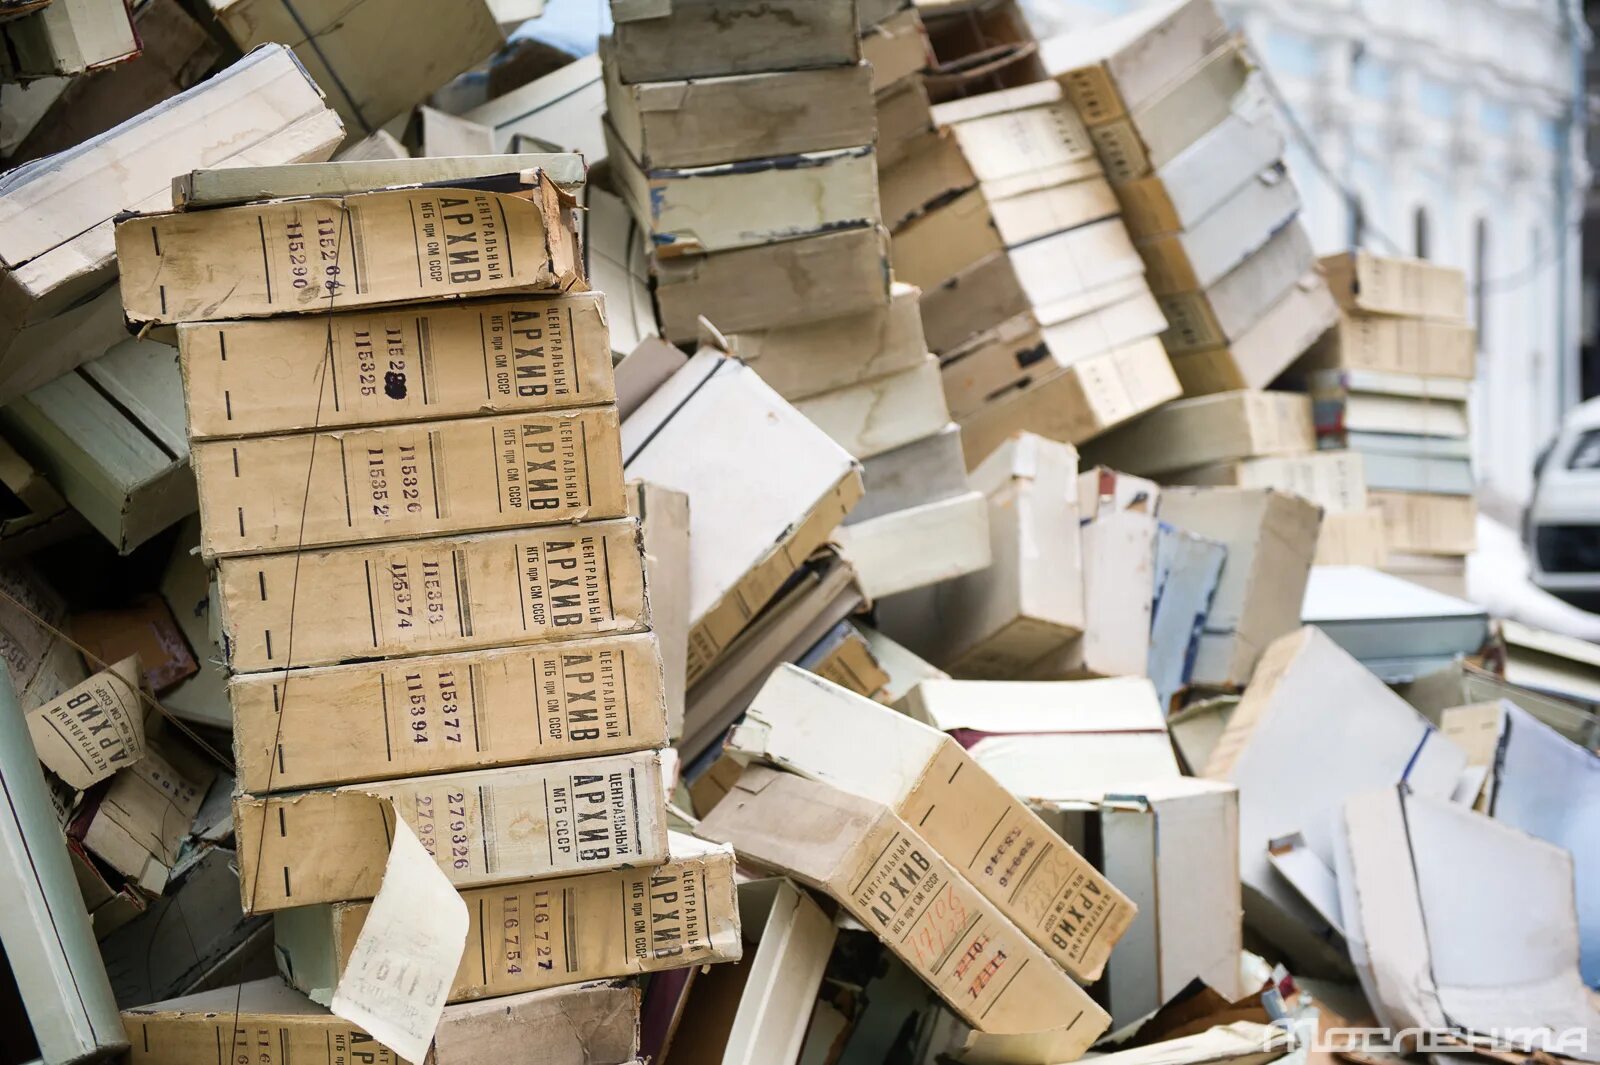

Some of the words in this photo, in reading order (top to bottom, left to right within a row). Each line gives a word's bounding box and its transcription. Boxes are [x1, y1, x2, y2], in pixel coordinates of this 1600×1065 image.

[421, 202, 433, 219] КГБ
[440, 198, 481, 284] АРХИВ
[475, 196, 503, 280] ЦЕНТРАЛЬНЫЙ
[287, 222, 308, 289] 115290
[427, 242, 439, 256] СМ
[428, 260, 443, 282] СССР
[491, 315, 504, 332] КГБ
[511, 311, 548, 397] АРХИВ
[546, 308, 570, 395] ЦЕНТРАЛЬНЫЙ
[354, 332, 377, 397] 115325
[385, 329, 408, 400] 1152
[495, 354, 507, 368] СМ
[497, 372, 510, 395] СССР
[503, 429, 516, 446] КГБ
[523, 424, 560, 510] АРХИВ
[559, 421, 581, 508] ЦЕНТРАЛЬНЫЙ
[368, 449, 389, 517] 115352
[399, 446, 422, 513] 115326
[507, 468, 519, 482] СМ
[508, 485, 522, 508] СССР
[526, 546, 539, 563] КГБ
[546, 541, 583, 627] АРХИВ
[580, 536, 604, 624] ЦЕНТРАЛЬНЫЙ
[391, 564, 413, 629] 115374
[422, 562, 443, 624] 115353
[530, 585, 542, 600] СМ
[532, 603, 545, 625] СССР
[543, 660, 557, 677] КГБ
[563, 655, 600, 741] АРХИВ
[599, 651, 621, 738] ЦЕНТРАЛЬНЫЙ
[50, 706, 108, 771] ЦЕНТРАЛЬНЫЙ
[67, 693, 127, 762] АРХИВ
[405, 674, 428, 743] 115394
[438, 671, 461, 743] 115377
[547, 699, 559, 713] СМ
[548, 717, 562, 740] СССР
[447, 792, 469, 869] 279326
[552, 787, 567, 814] МГБ
[573, 775, 610, 861] АРХИВ
[608, 772, 632, 855] ЦЕНТРАЛЬНЫЙ
[555, 820, 570, 854] СССР
[632, 882, 644, 899] КГБ
[859, 838, 911, 907] ЦЕНТРАЛЬНЫЙ
[871, 850, 930, 927] АРХИВ
[913, 891, 926, 906] СМ
[922, 872, 940, 893] СССР
[504, 895, 522, 975] 116754
[534, 890, 553, 970] 116727
[634, 920, 646, 934] СМ
[635, 937, 647, 959] СССР
[650, 876, 683, 959] АРХИВ
[1051, 879, 1102, 950] АРХИВ
